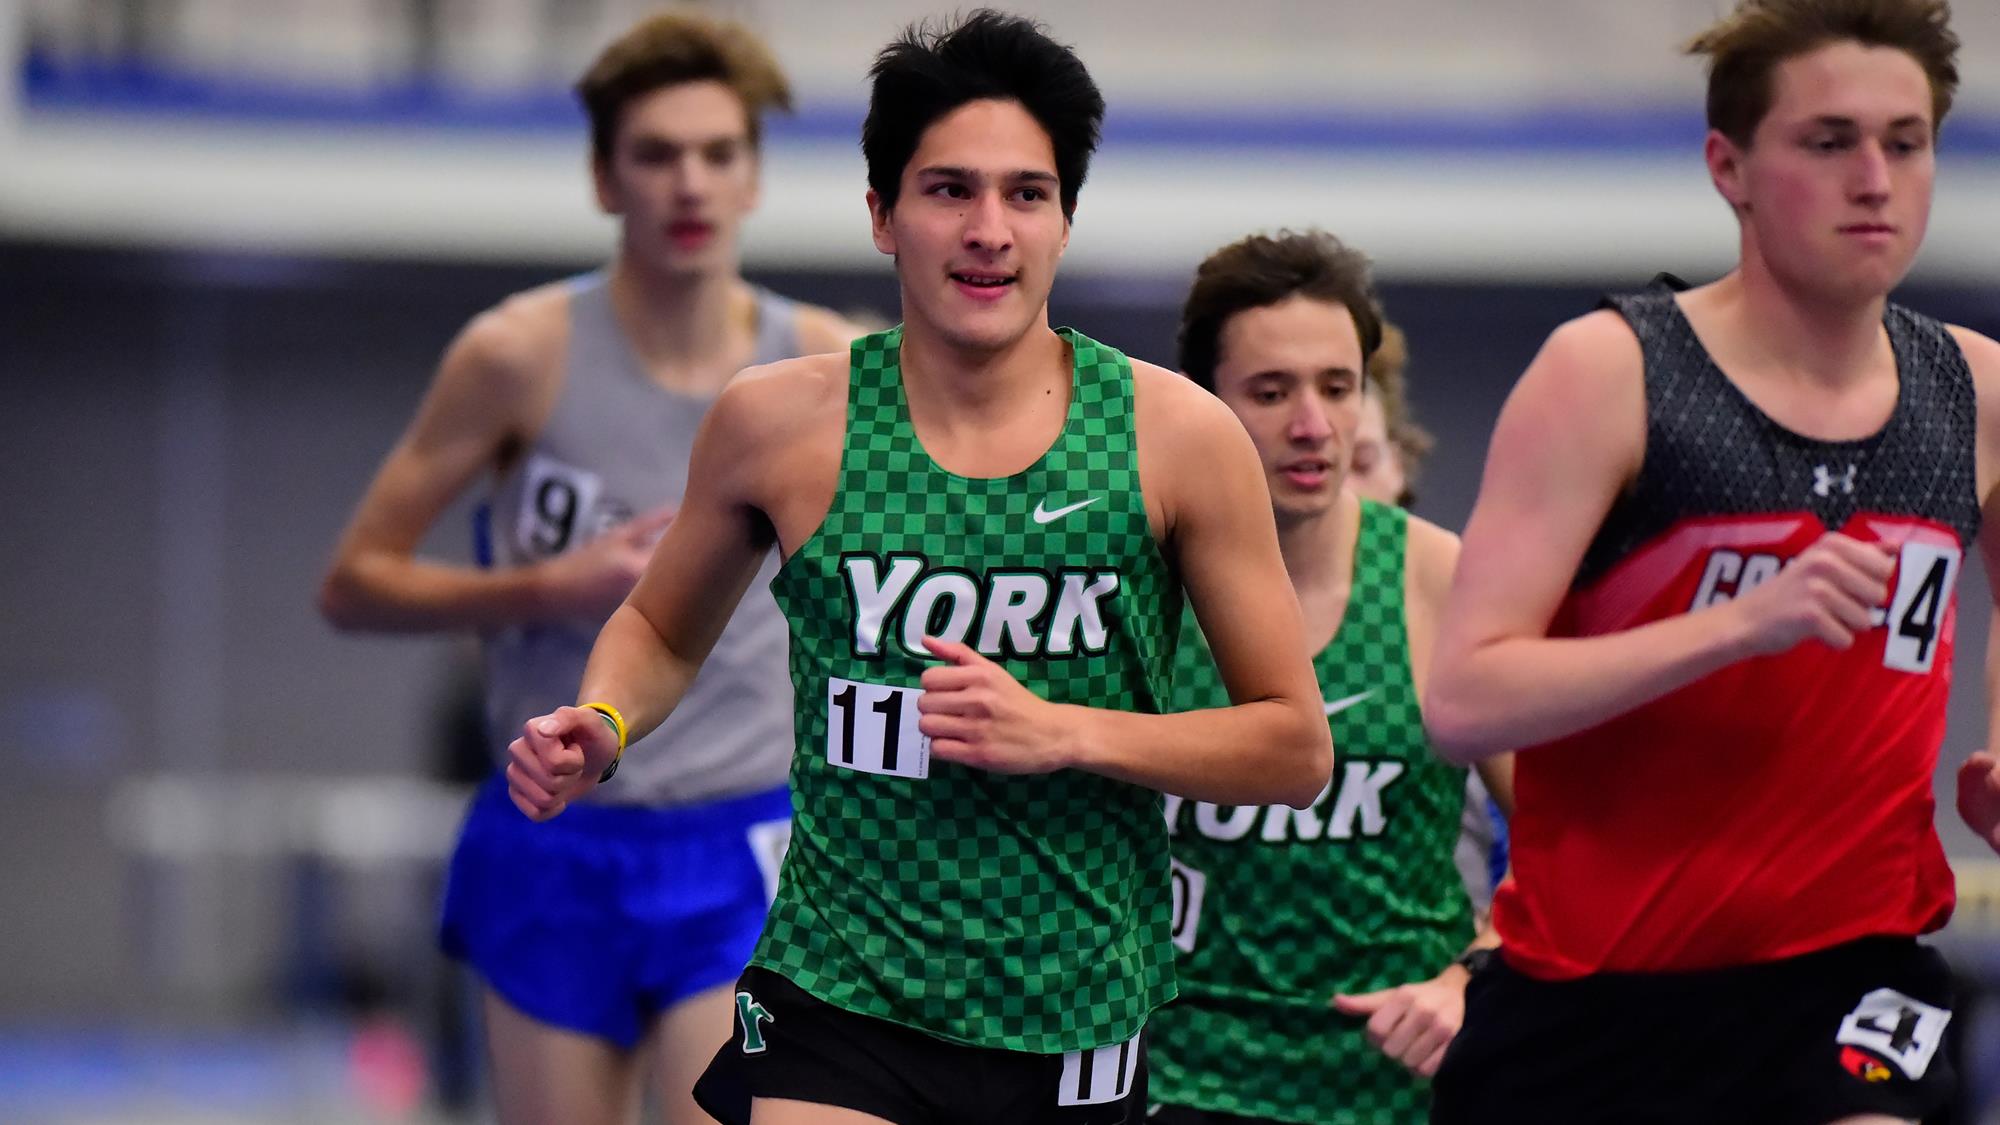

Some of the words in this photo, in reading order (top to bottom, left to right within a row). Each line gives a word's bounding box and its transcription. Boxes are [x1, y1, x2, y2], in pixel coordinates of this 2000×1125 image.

[533, 477, 578, 556] 9
[841, 553, 1120, 658] YORK
[1899, 556, 1949, 663] 4
[832, 684, 904, 771] 11
